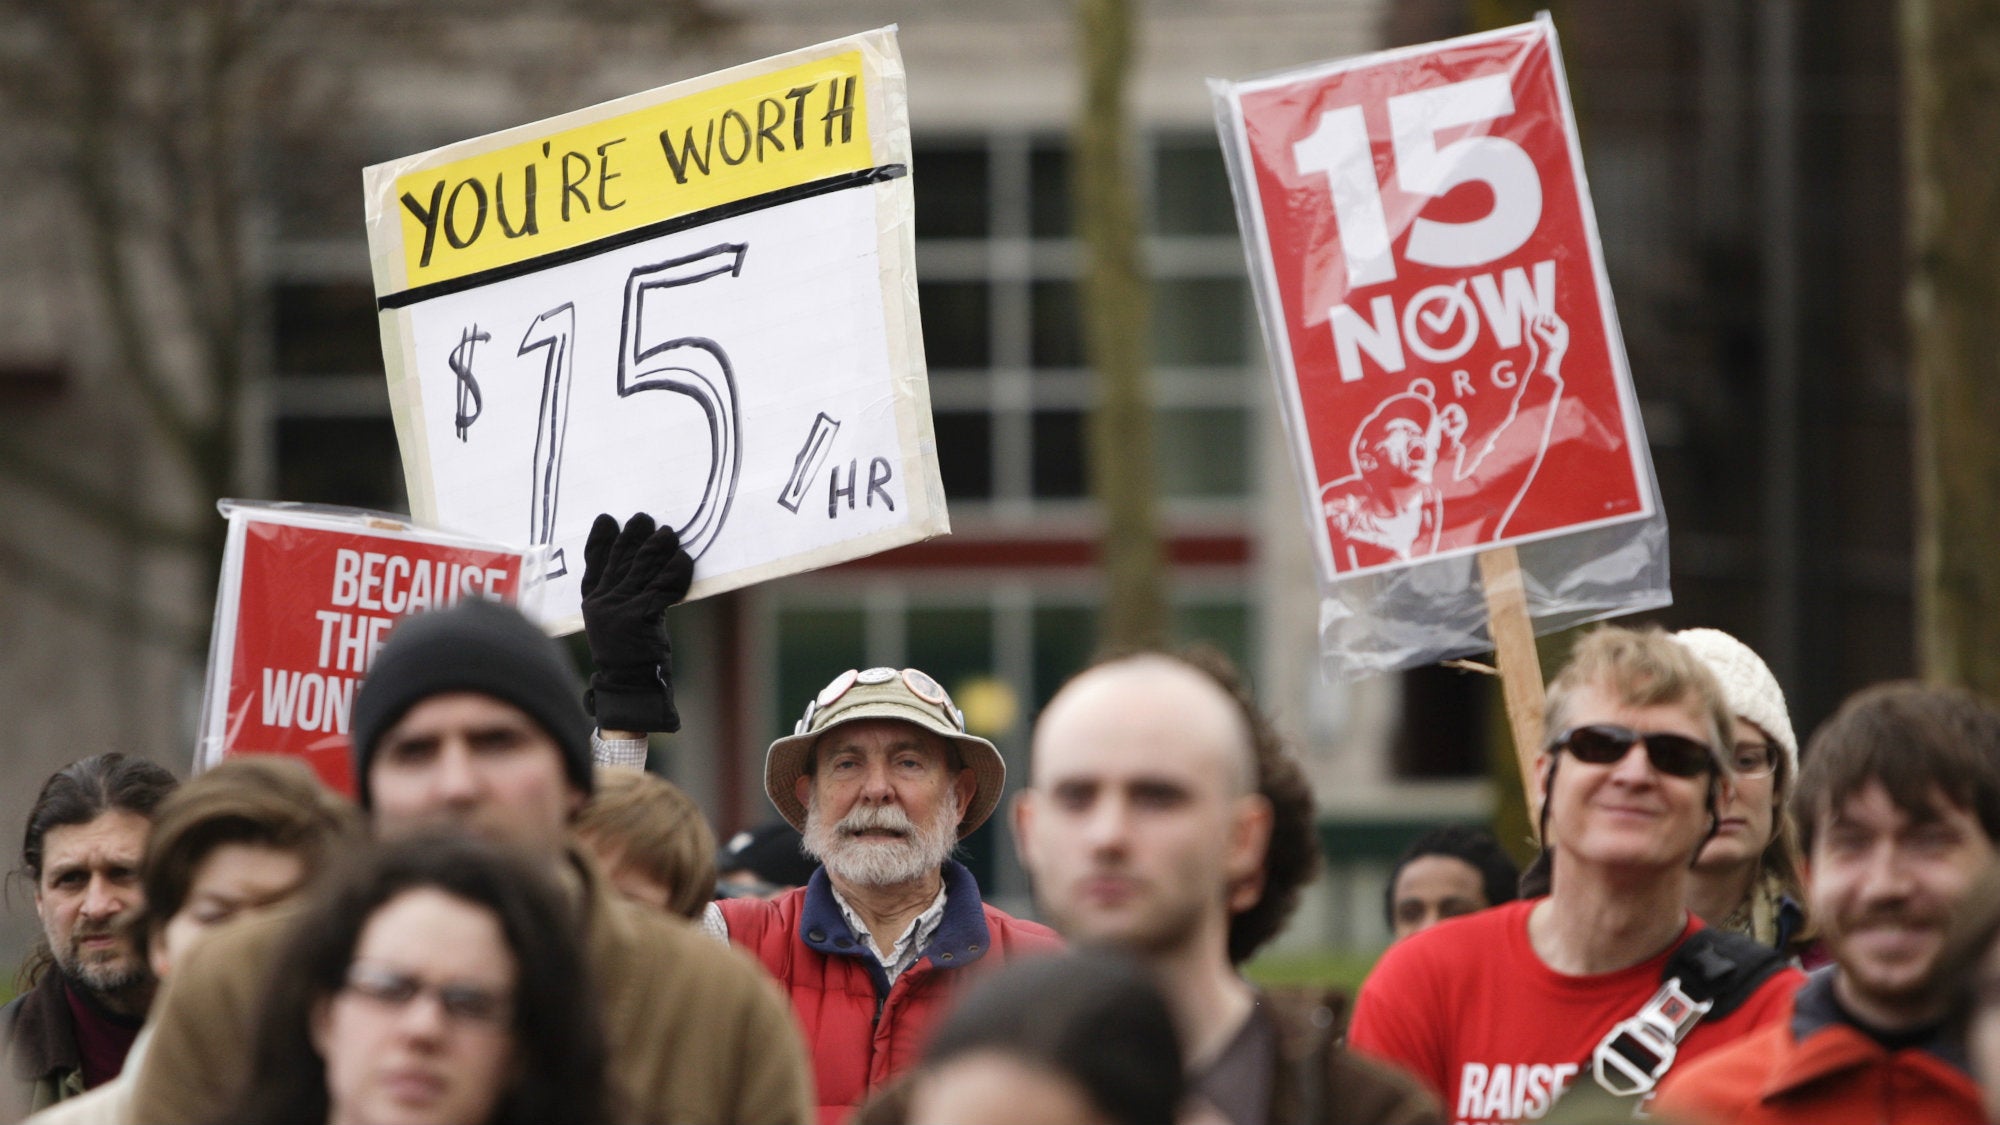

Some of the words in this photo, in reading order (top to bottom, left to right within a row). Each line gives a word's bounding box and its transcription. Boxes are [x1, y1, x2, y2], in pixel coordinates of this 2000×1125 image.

[401, 137, 627, 267] YOU'RE
[660, 75, 857, 184] WORTH
[1293, 73, 1542, 288] 15
[1329, 260, 1556, 383] NOW
[262, 667, 366, 735] WON
